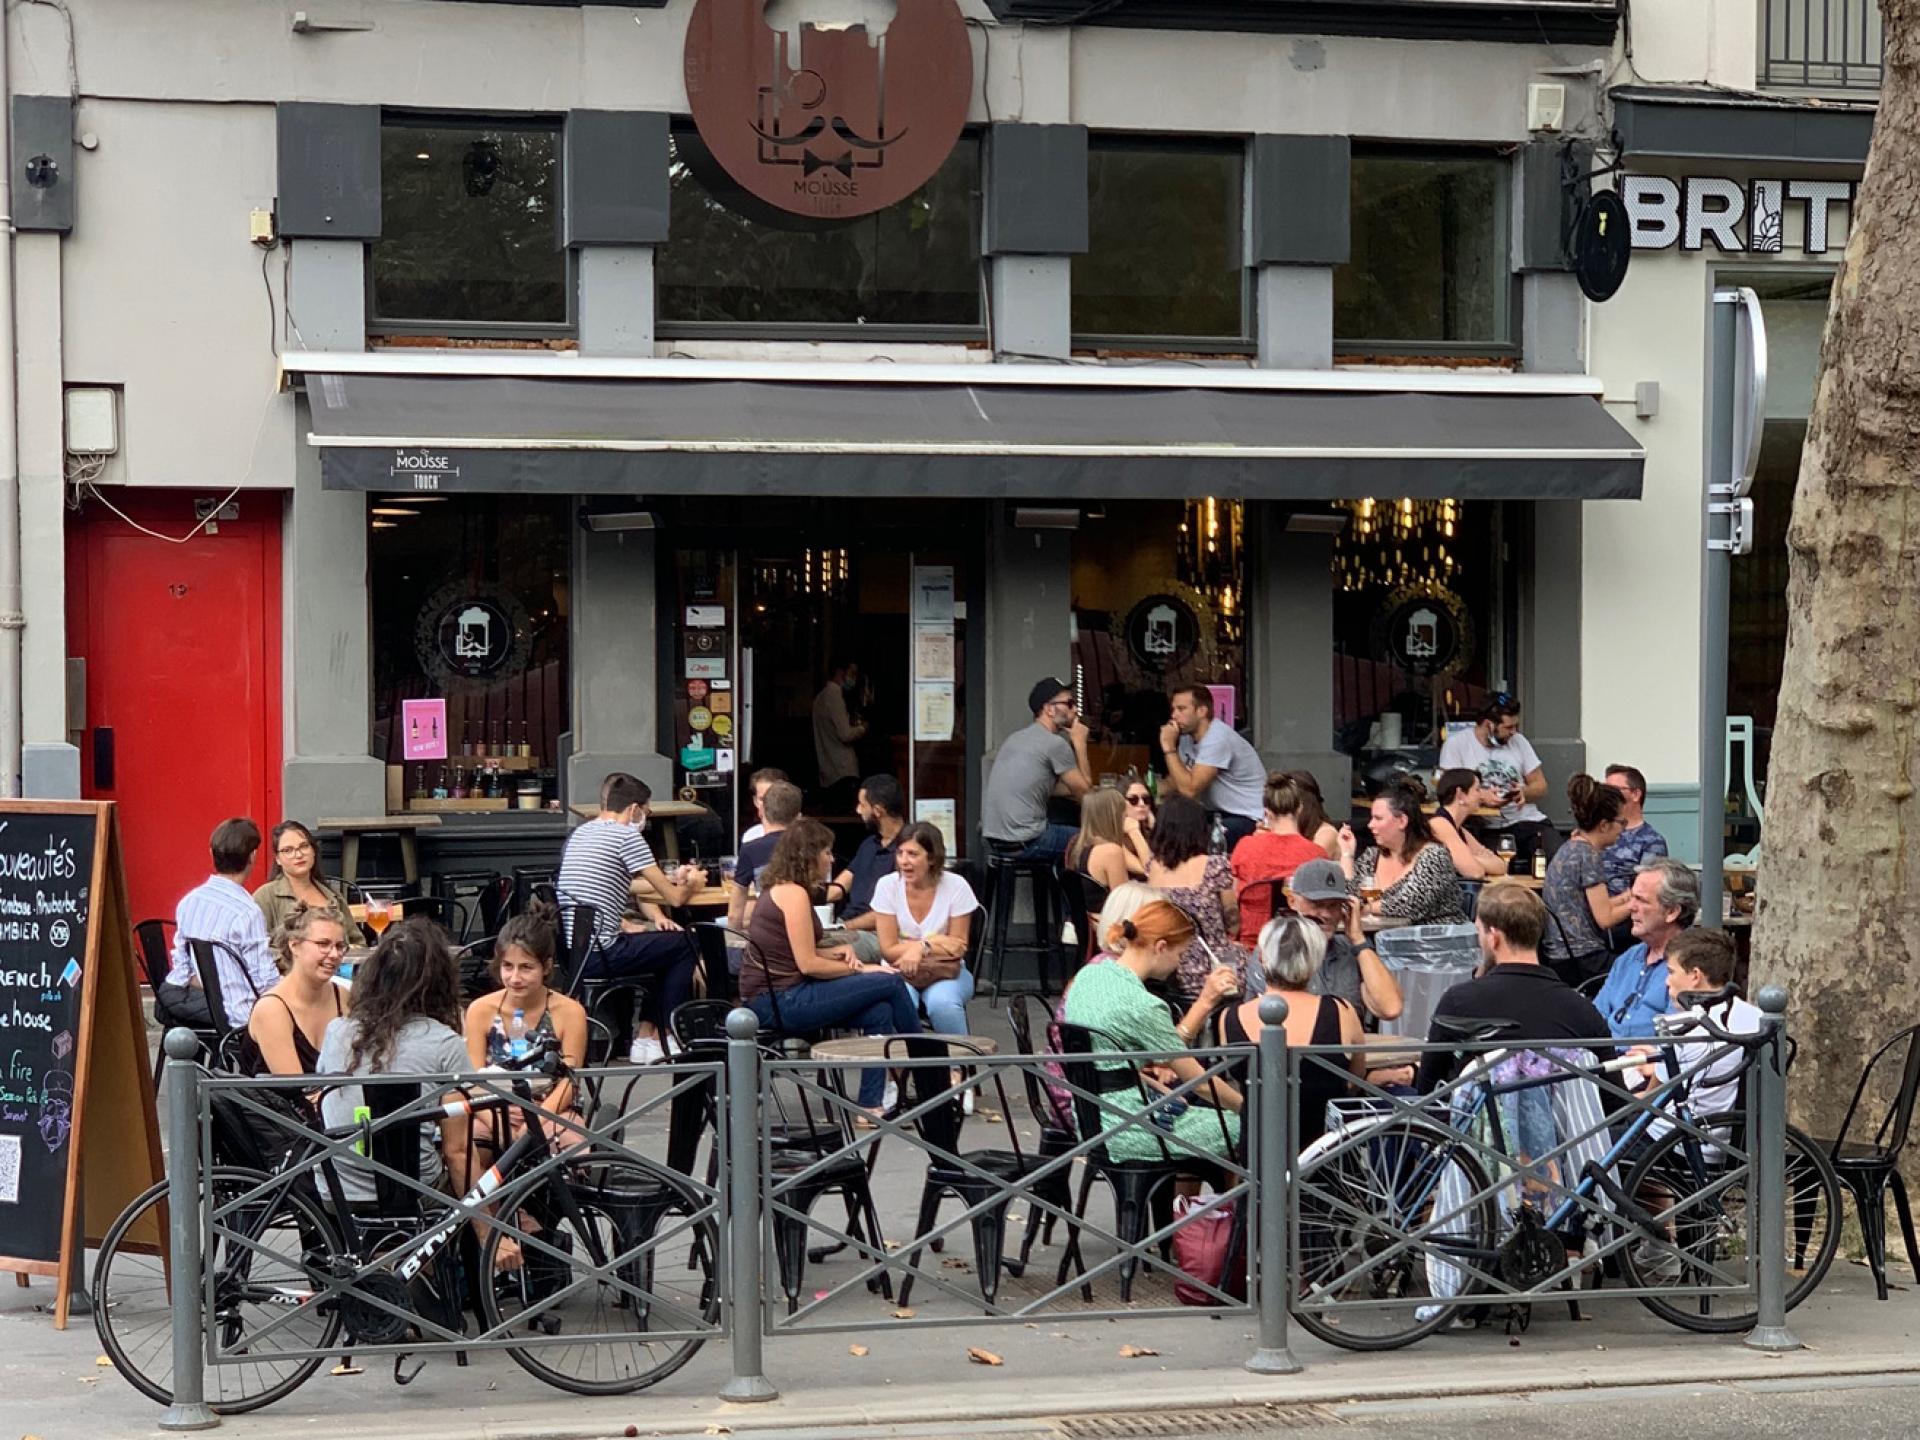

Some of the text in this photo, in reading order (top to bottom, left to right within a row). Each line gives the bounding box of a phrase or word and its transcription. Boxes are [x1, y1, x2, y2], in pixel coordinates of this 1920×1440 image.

[793, 181, 859, 196] MOUSSE
[1622, 174, 1860, 254] BRIT
[396, 455, 449, 469] MOUSSE
[12, 998, 53, 1032] house
